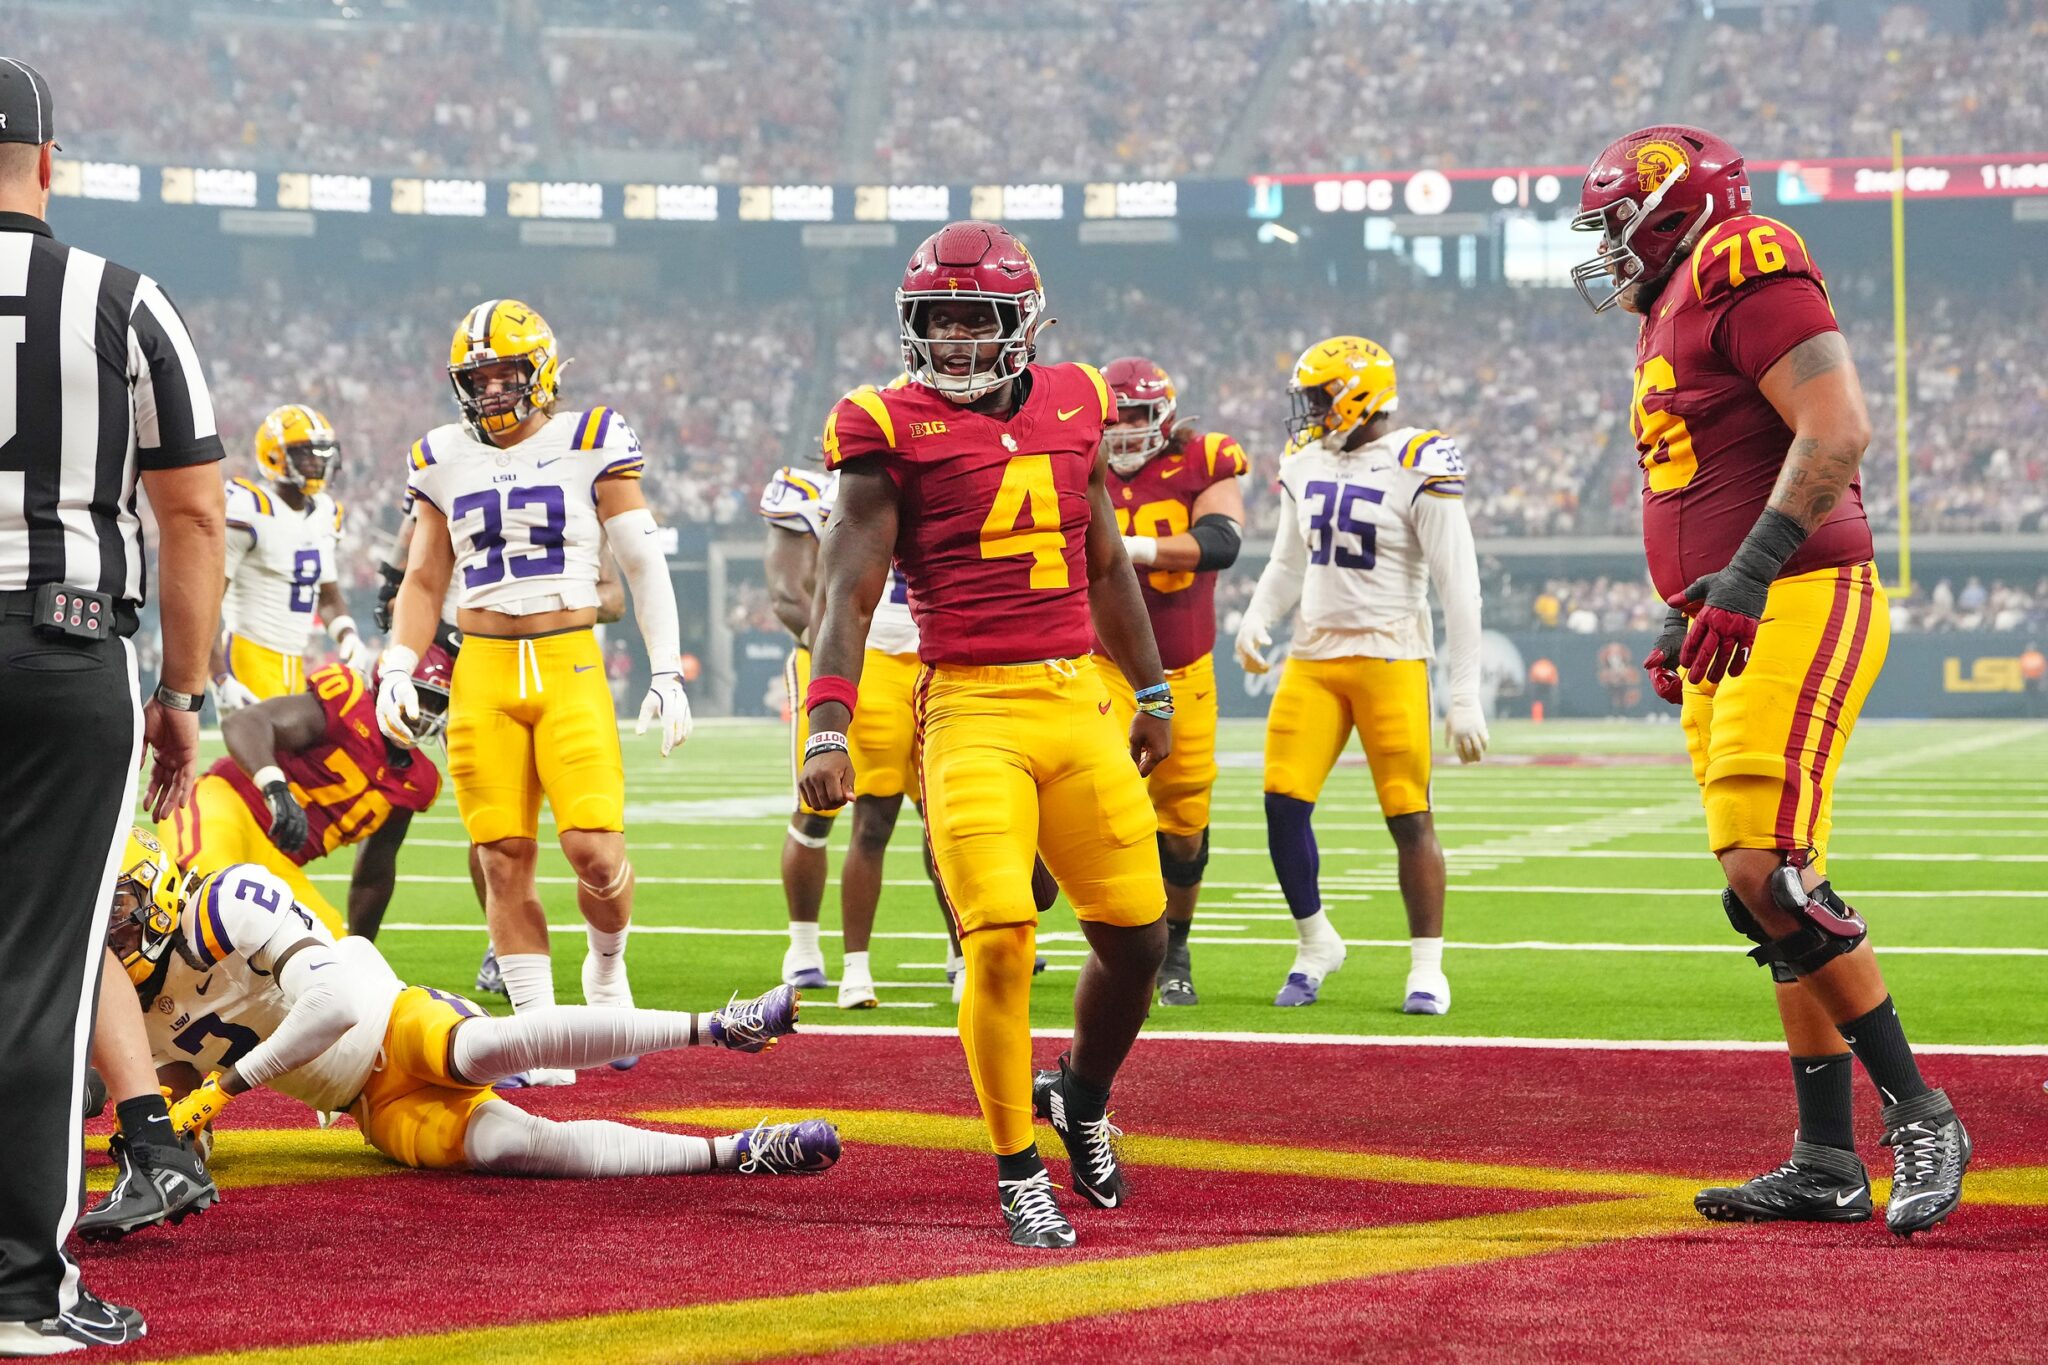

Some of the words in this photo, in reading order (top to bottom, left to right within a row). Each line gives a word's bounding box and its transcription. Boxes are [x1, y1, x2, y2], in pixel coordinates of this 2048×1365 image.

[1313, 179, 1393, 212] USC
[1711, 224, 1787, 288] 76
[1323, 340, 1380, 358] LSU
[822, 412, 842, 464] 4
[492, 473, 518, 484] LSU
[451, 484, 567, 590] 33
[979, 453, 1070, 590] 4
[1304, 480, 1386, 570] 35
[289, 549, 322, 613] 8
[310, 662, 350, 701] 70
[234, 878, 281, 914] 2
[169, 1012, 191, 1032] LSU
[1049, 1089, 1069, 1133] NIKE
